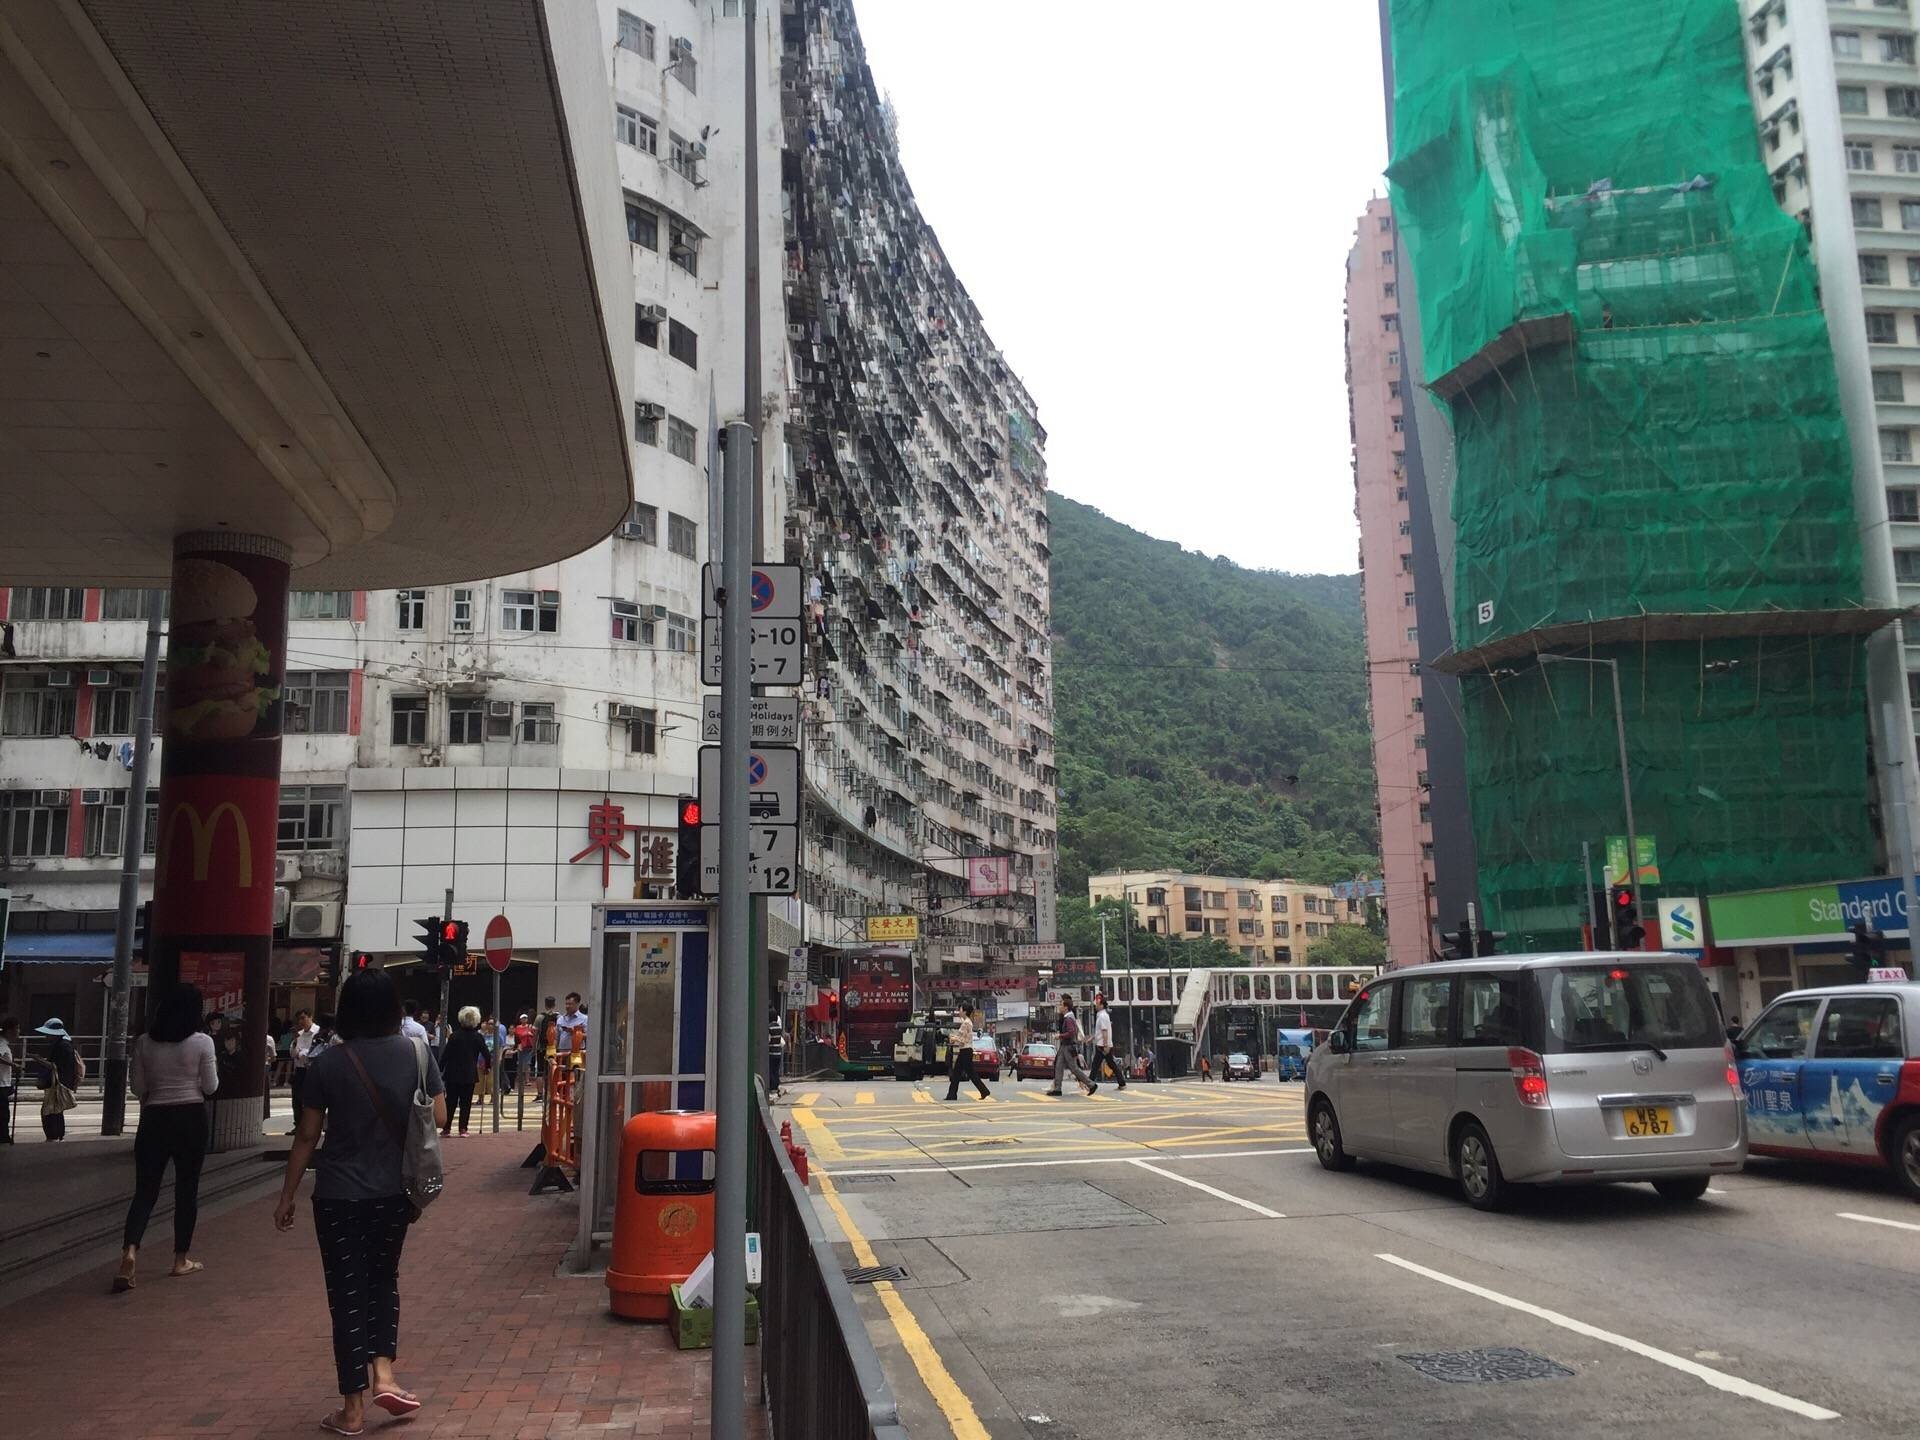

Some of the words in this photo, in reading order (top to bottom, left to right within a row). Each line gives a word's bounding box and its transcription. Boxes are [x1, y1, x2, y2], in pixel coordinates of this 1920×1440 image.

[1481, 604, 1491, 620] 5
[750, 711, 794, 722] Holidays
[763, 829, 778, 851] 7
[764, 866, 790, 889] 12
[1809, 893, 1891, 922] Standard
[641, 960, 670, 968] PCCW
[1876, 969, 1905, 980] TAXI
[1636, 1107, 1658, 1121] WB
[1629, 1120, 1669, 1136] 6787
